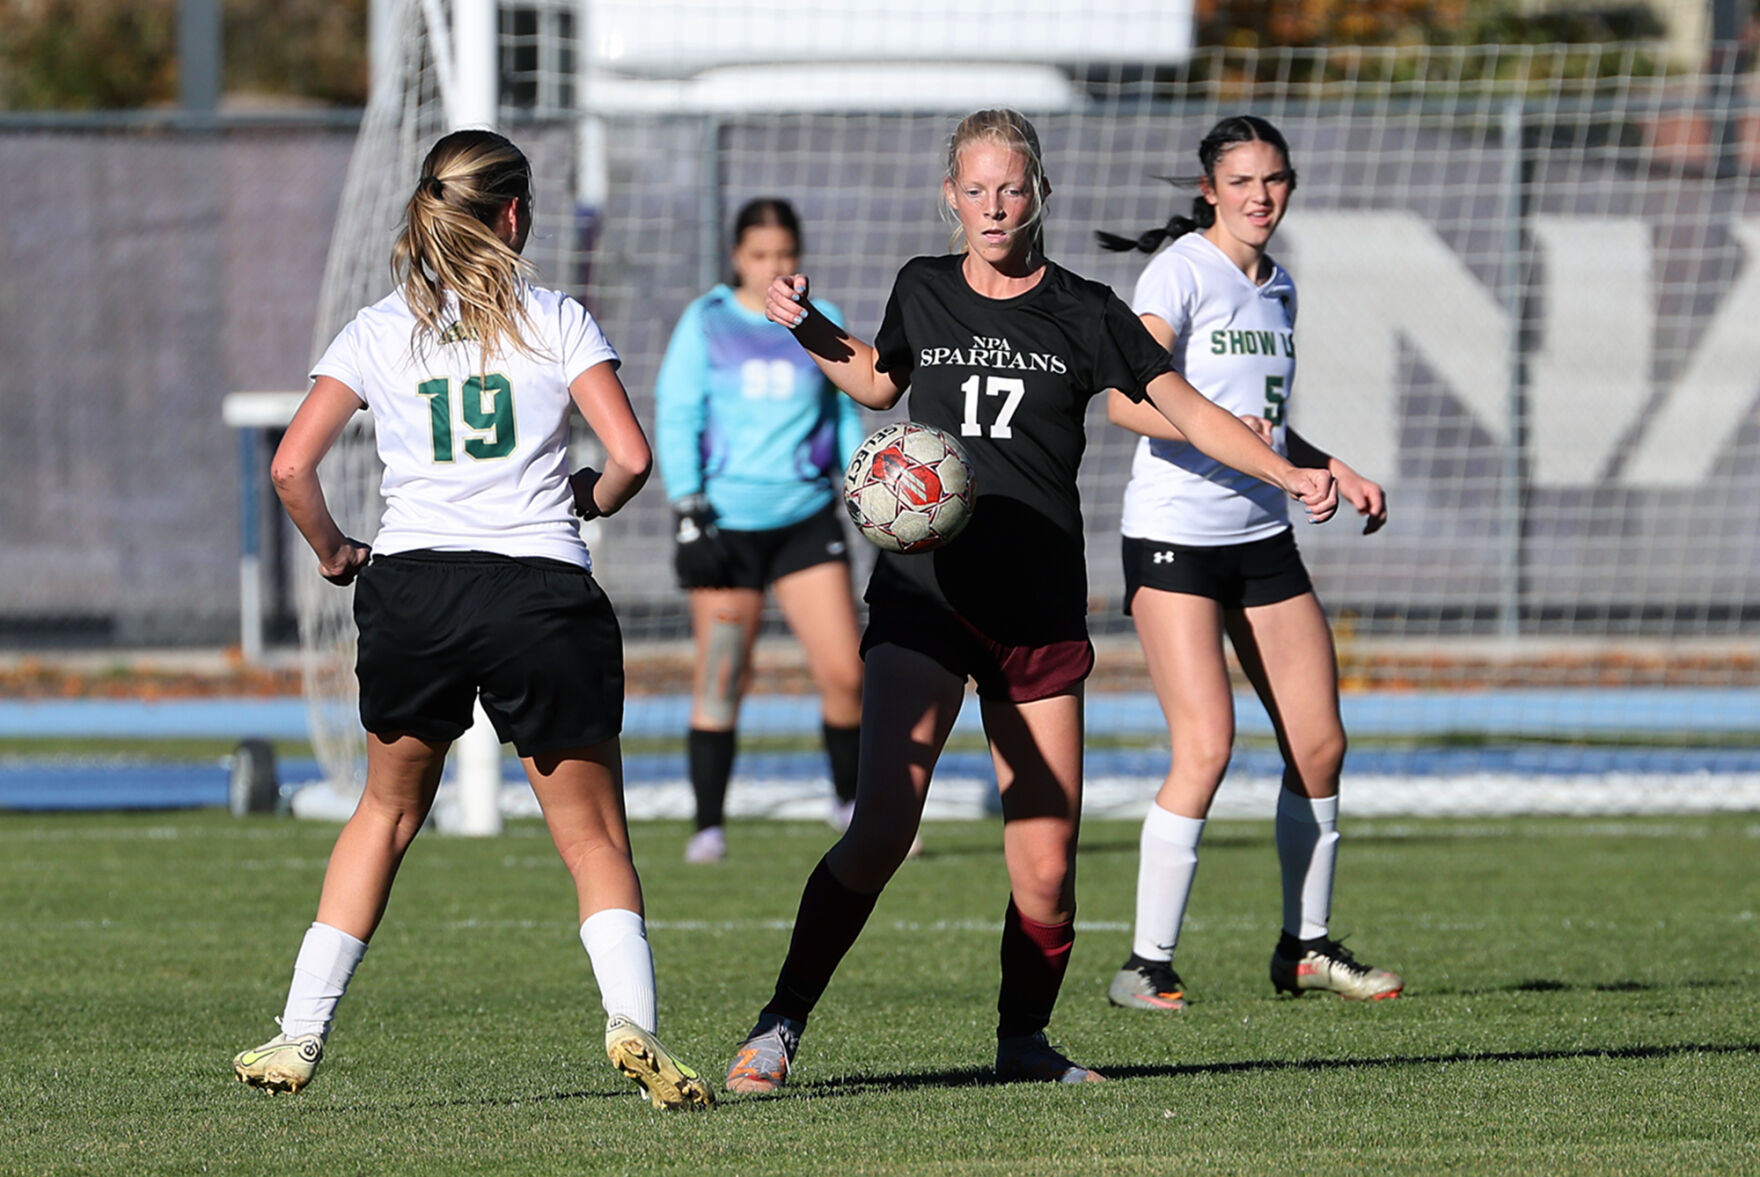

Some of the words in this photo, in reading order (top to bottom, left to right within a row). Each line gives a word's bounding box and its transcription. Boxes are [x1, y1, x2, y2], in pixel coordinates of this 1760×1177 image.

[920, 347, 1067, 375] SPARTANS
[972, 335, 1011, 351] NPA
[1211, 330, 1276, 356] SHOW
[416, 373, 519, 464] 19
[960, 374, 1025, 439] 17
[1263, 375, 1285, 427] 5
[847, 423, 898, 485] SELECT
